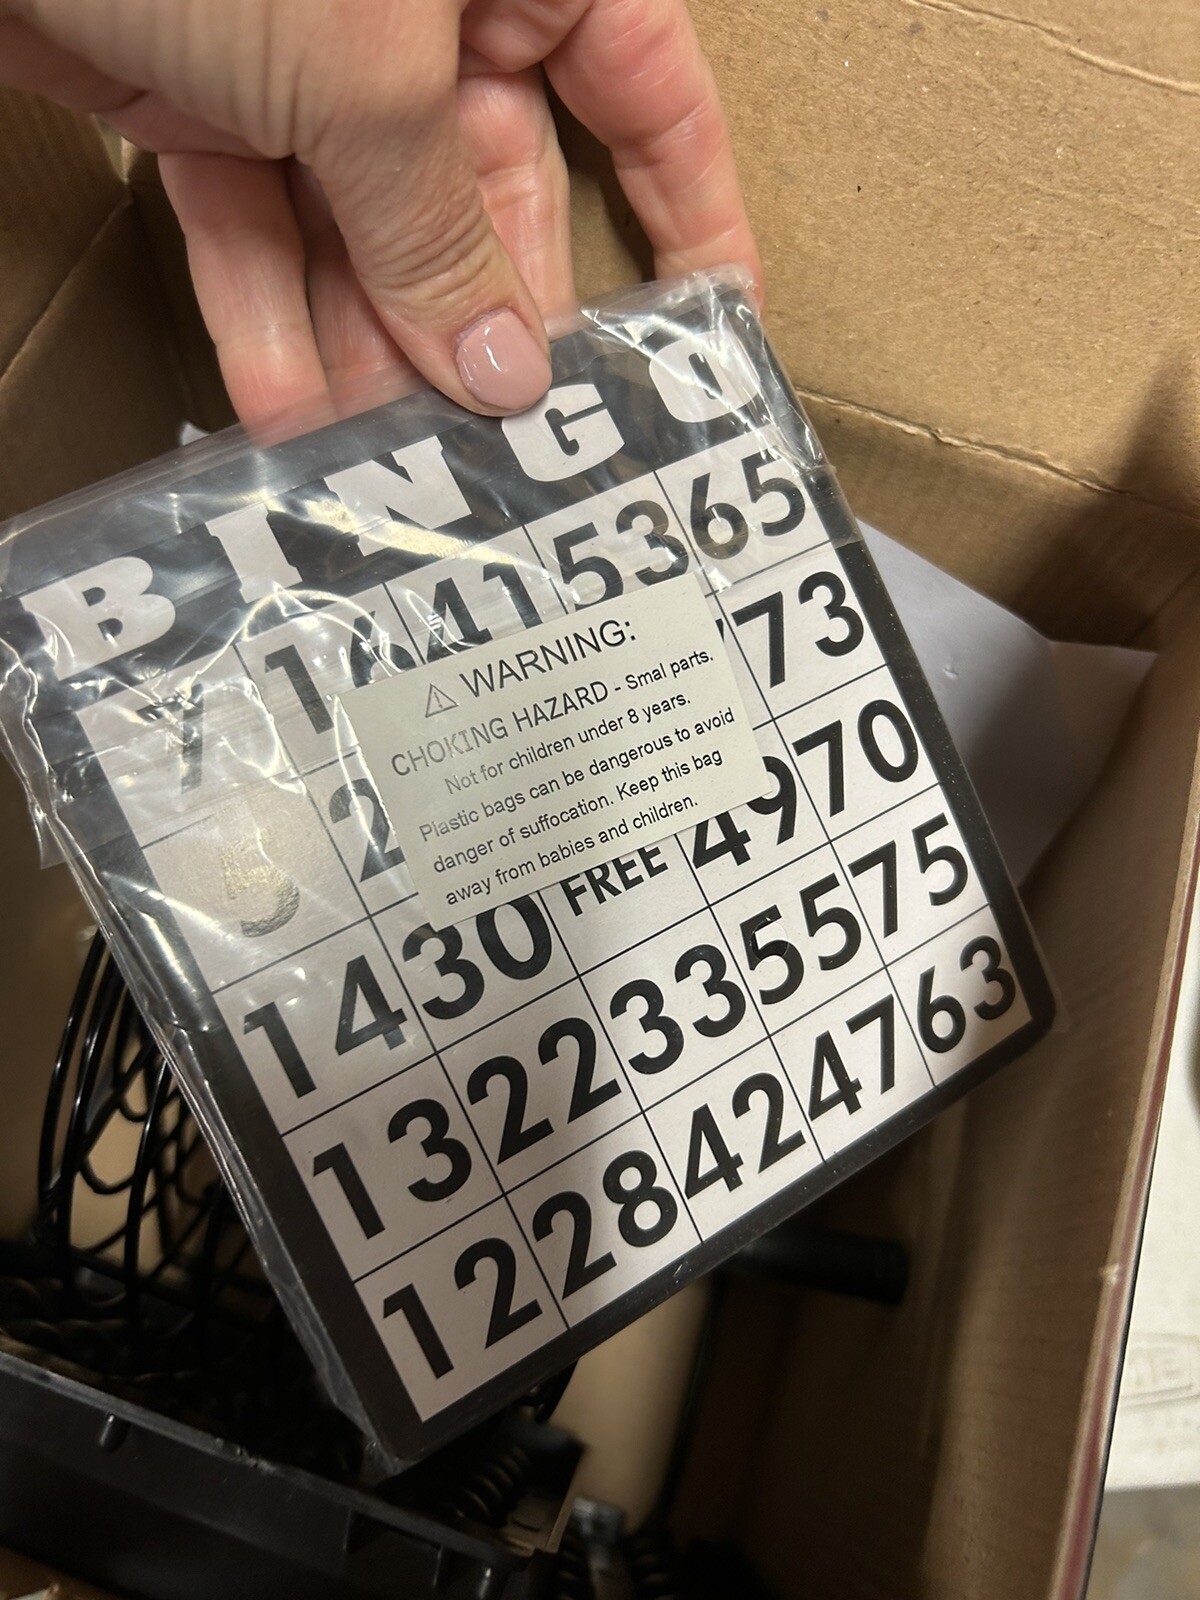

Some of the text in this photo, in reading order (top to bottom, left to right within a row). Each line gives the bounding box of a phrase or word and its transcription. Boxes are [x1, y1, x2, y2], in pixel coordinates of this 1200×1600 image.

[426, 561, 544, 664] 41
[552, 499, 690, 612] 53
[689, 453, 806, 561] 65
[459, 620, 636, 697] WARNING:
[732, 571, 864, 688] 73
[391, 718, 508, 776] CHOKING
[512, 681, 608, 732] HAZARD
[625, 663, 667, 690] Smal
[670, 651, 714, 678] parts.
[419, 707, 735, 842] Plastic bags can be dangerous to avoid
[444, 693, 691, 795] Not for children under 8 years.
[433, 750, 723, 873] danger of suffocation. Keep this bag
[446, 796, 698, 905] away from babies and children.
[243, 699, 919, 1098] 14 30 FREE 49 70
[313, 813, 968, 1239] 13 22 33 55 75
[383, 936, 1016, 1379] 12 28 42 47 63
